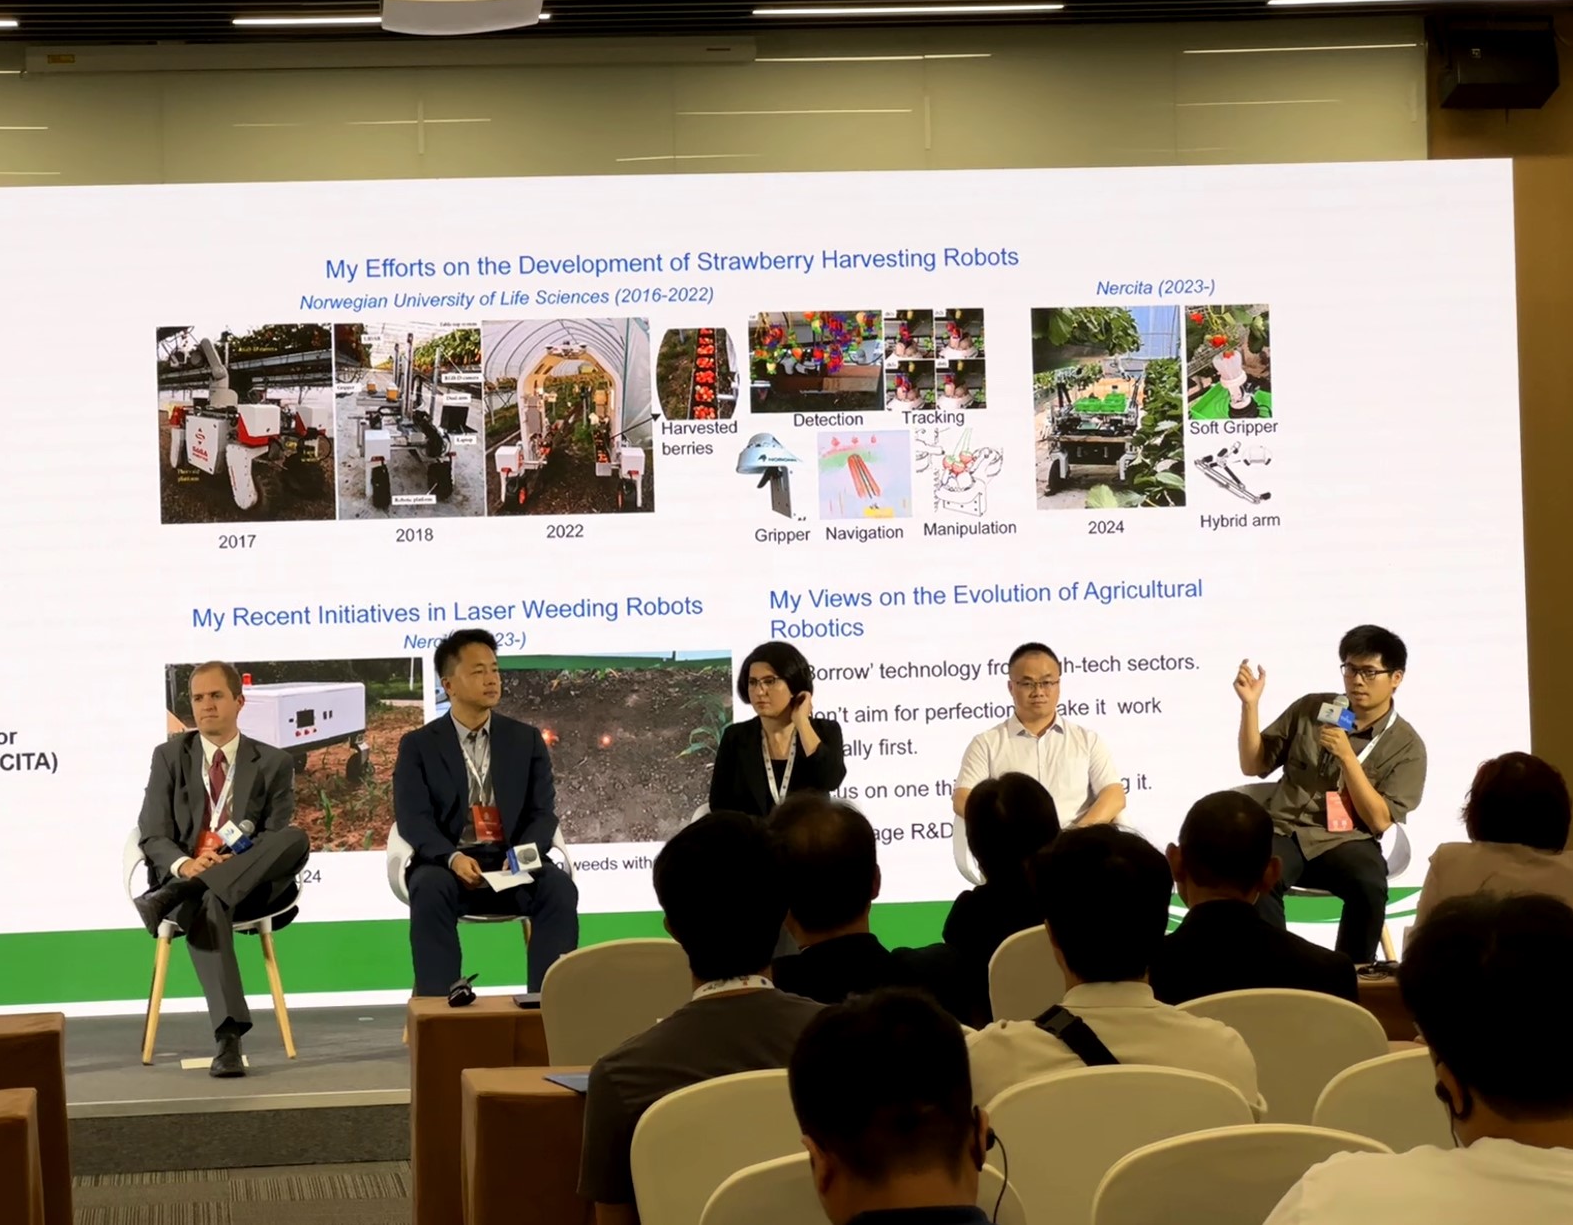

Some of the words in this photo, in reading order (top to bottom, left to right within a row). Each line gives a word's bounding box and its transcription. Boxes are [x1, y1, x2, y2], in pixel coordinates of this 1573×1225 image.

[327, 260, 358, 283] My
[367, 259, 435, 277] Efforts
[444, 262, 469, 276] on
[478, 257, 511, 275] the
[520, 254, 662, 277] Development
[670, 253, 690, 271] of
[698, 252, 814, 273] Strawberry
[823, 249, 935, 271] Harvesting
[945, 248, 1018, 266] Robots
[1097, 281, 1152, 295] Nercita
[1159, 280, 1214, 297] (2023-)
[300, 295, 387, 312] Norwegian
[394, 293, 474, 309] University
[480, 291, 496, 305] of
[501, 291, 529, 305] Life
[536, 290, 609, 304] Sciences
[615, 287, 713, 306] (2016-2022)
[661, 419, 738, 437] Harvested
[793, 412, 864, 427] Detection
[902, 410, 965, 427] Tracking
[1190, 419, 1218, 436] Soft
[1222, 419, 1279, 439] Gripper
[662, 441, 713, 455] berries
[755, 529, 810, 544] Gripper
[826, 526, 903, 542] Navigation
[924, 521, 1016, 538] Manipulation
[1089, 521, 1124, 534] 2024
[1201, 514, 1247, 531] Hybrid
[1253, 516, 1280, 526] arm
[219, 535, 256, 548] 2017
[397, 528, 433, 542] 2018
[547, 524, 583, 538] 2022
[771, 590, 801, 613] My
[809, 590, 872, 607] Views
[880, 592, 905, 606] on
[913, 587, 946, 605] the
[955, 584, 1050, 603] Evolution
[1059, 582, 1079, 600] of
[1084, 579, 1202, 604] Agricultural
[193, 609, 224, 631] My
[234, 607, 310, 626] Recent
[319, 604, 420, 623] Initiatives
[429, 603, 445, 621] in
[455, 603, 515, 620] Laser
[523, 599, 617, 621] Weeding
[627, 597, 702, 615] Robots
[772, 619, 864, 638] Robotics
[403, 633, 442, 650] Nerc
[495, 631, 527, 650] 23-)
[880, 661, 981, 680] technology
[987, 659, 1010, 676] fro
[1128, 655, 1199, 671] sectors.
[855, 706, 887, 722] aim
[895, 705, 919, 721] for
[925, 702, 1015, 724] perfection
[1057, 699, 1090, 716] ake
[1096, 699, 1106, 714] it
[1118, 697, 1161, 713] work
[842, 739, 872, 760] ally
[879, 739, 917, 755] first.
[865, 786, 887, 798] on
[895, 785, 929, 797] one
[1138, 774, 1151, 789] it.
[910, 821, 954, 841] R&D
[622, 856, 652, 871] with
